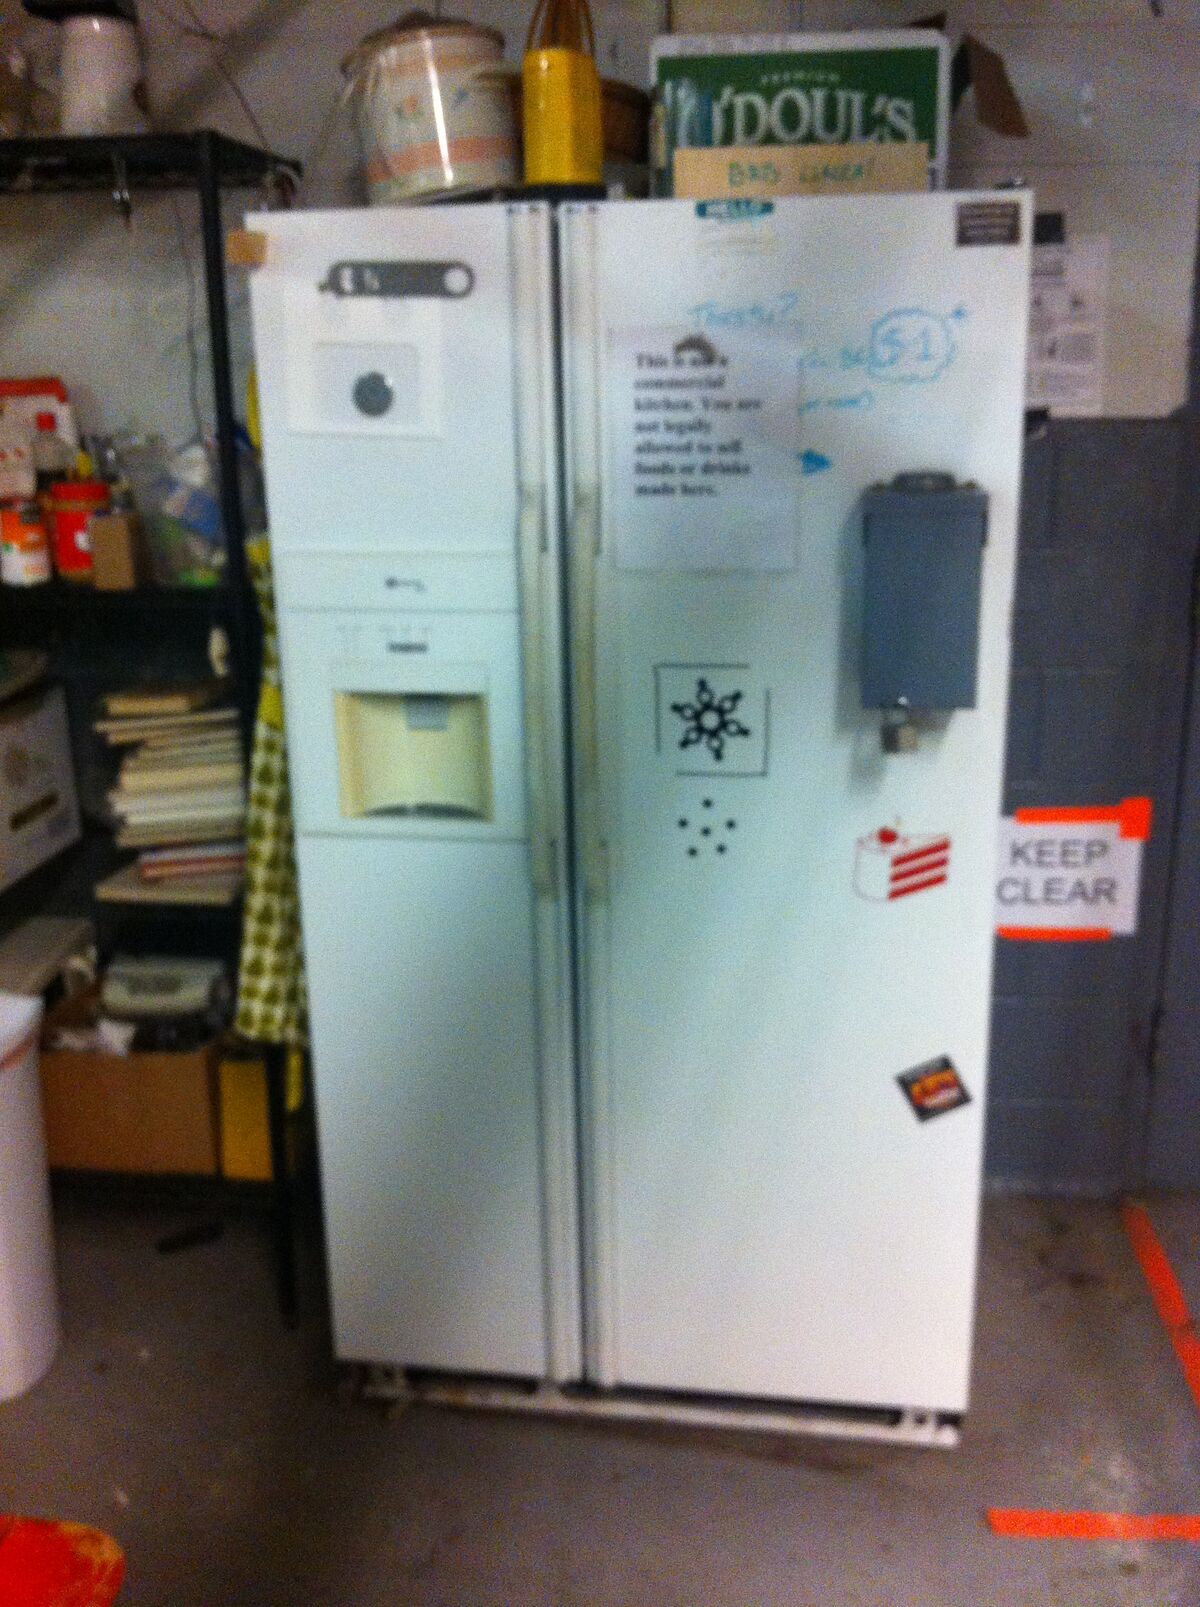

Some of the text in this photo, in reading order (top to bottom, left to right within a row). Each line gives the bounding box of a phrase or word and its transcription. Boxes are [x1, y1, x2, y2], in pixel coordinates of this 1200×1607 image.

[637, 353, 668, 368] This
[634, 374, 726, 390] commercial
[702, 396, 734, 412] You
[736, 398, 762, 411] are
[635, 417, 712, 436] not legally
[635, 437, 744, 455] allowed to sell
[634, 461, 751, 476] foods or drinks
[635, 481, 719, 497] made here.
[1009, 838, 1109, 868] KEEP
[995, 876, 1118, 906] CLEAR
